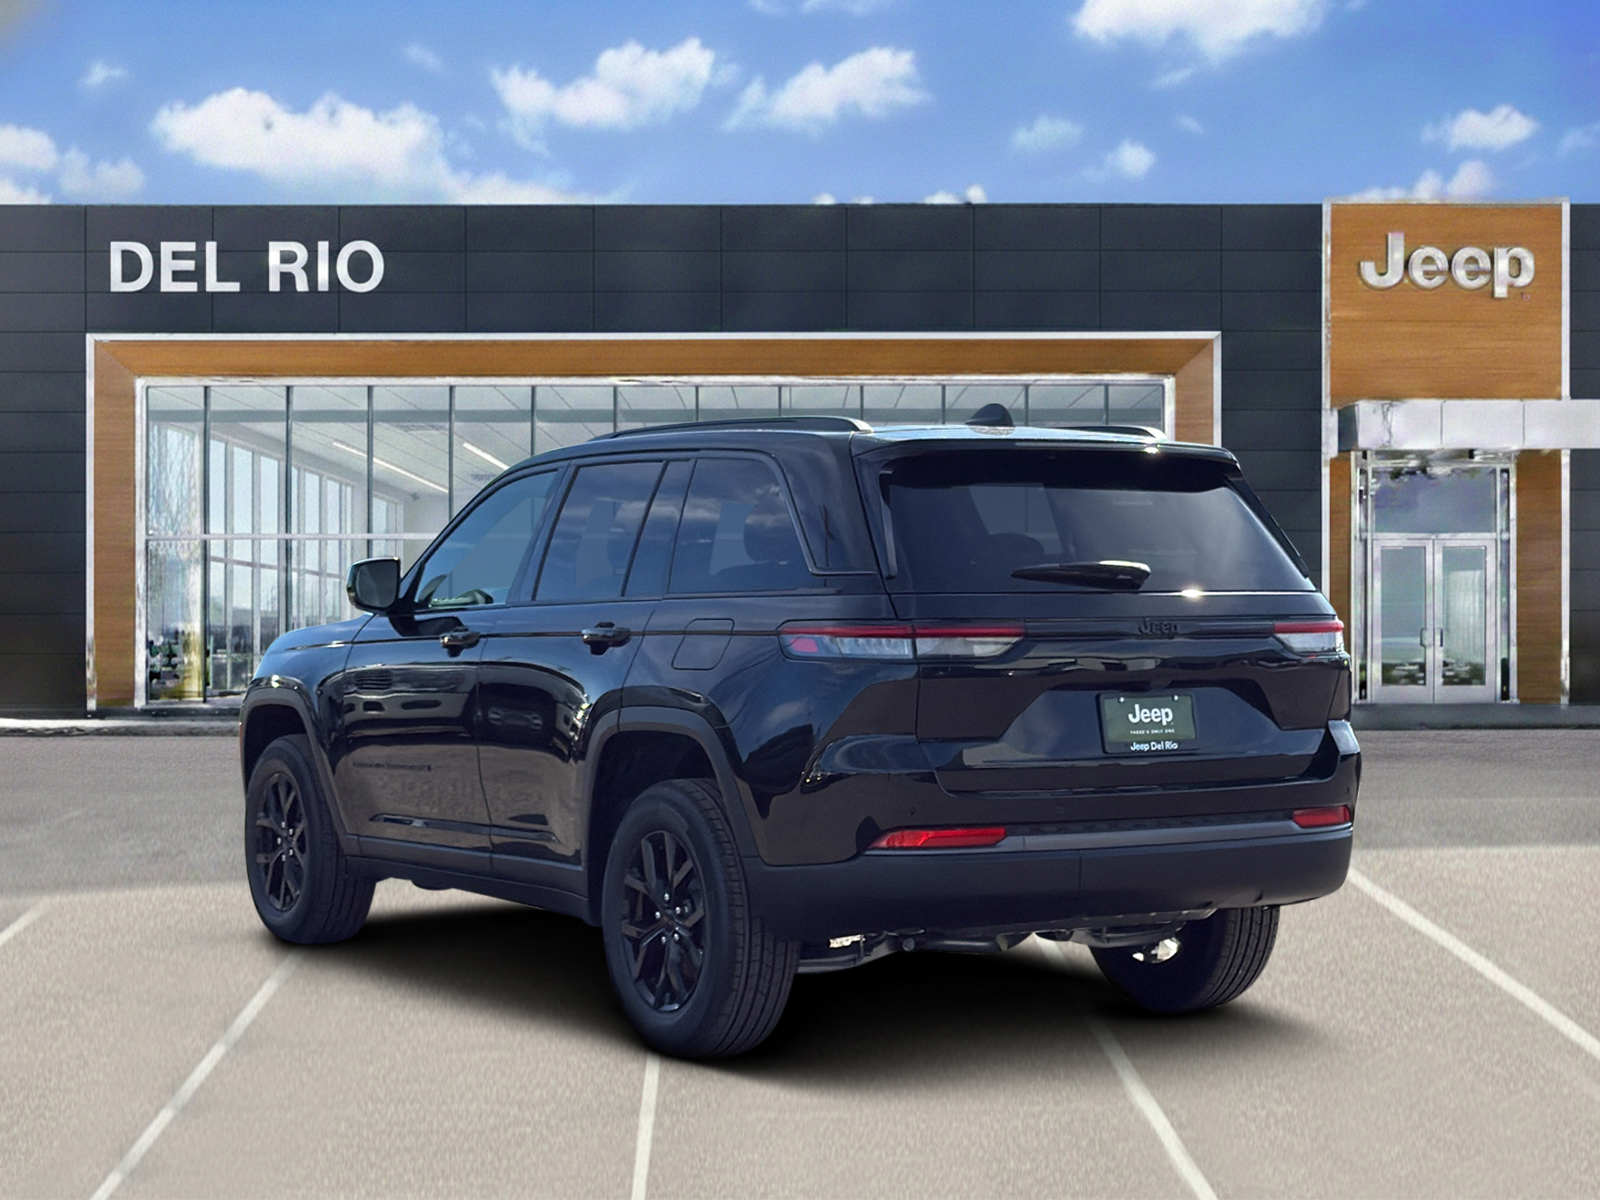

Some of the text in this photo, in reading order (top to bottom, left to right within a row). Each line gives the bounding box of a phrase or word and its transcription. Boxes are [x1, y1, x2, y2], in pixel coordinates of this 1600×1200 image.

[110, 240, 385, 293] DEL RIO
[1359, 231, 1535, 298] Jeep
[1137, 617, 1178, 639] Jeep
[1128, 703, 1173, 726] Jeep
[1130, 742, 1150, 751] Jeep
[1150, 741, 1164, 750] Del
